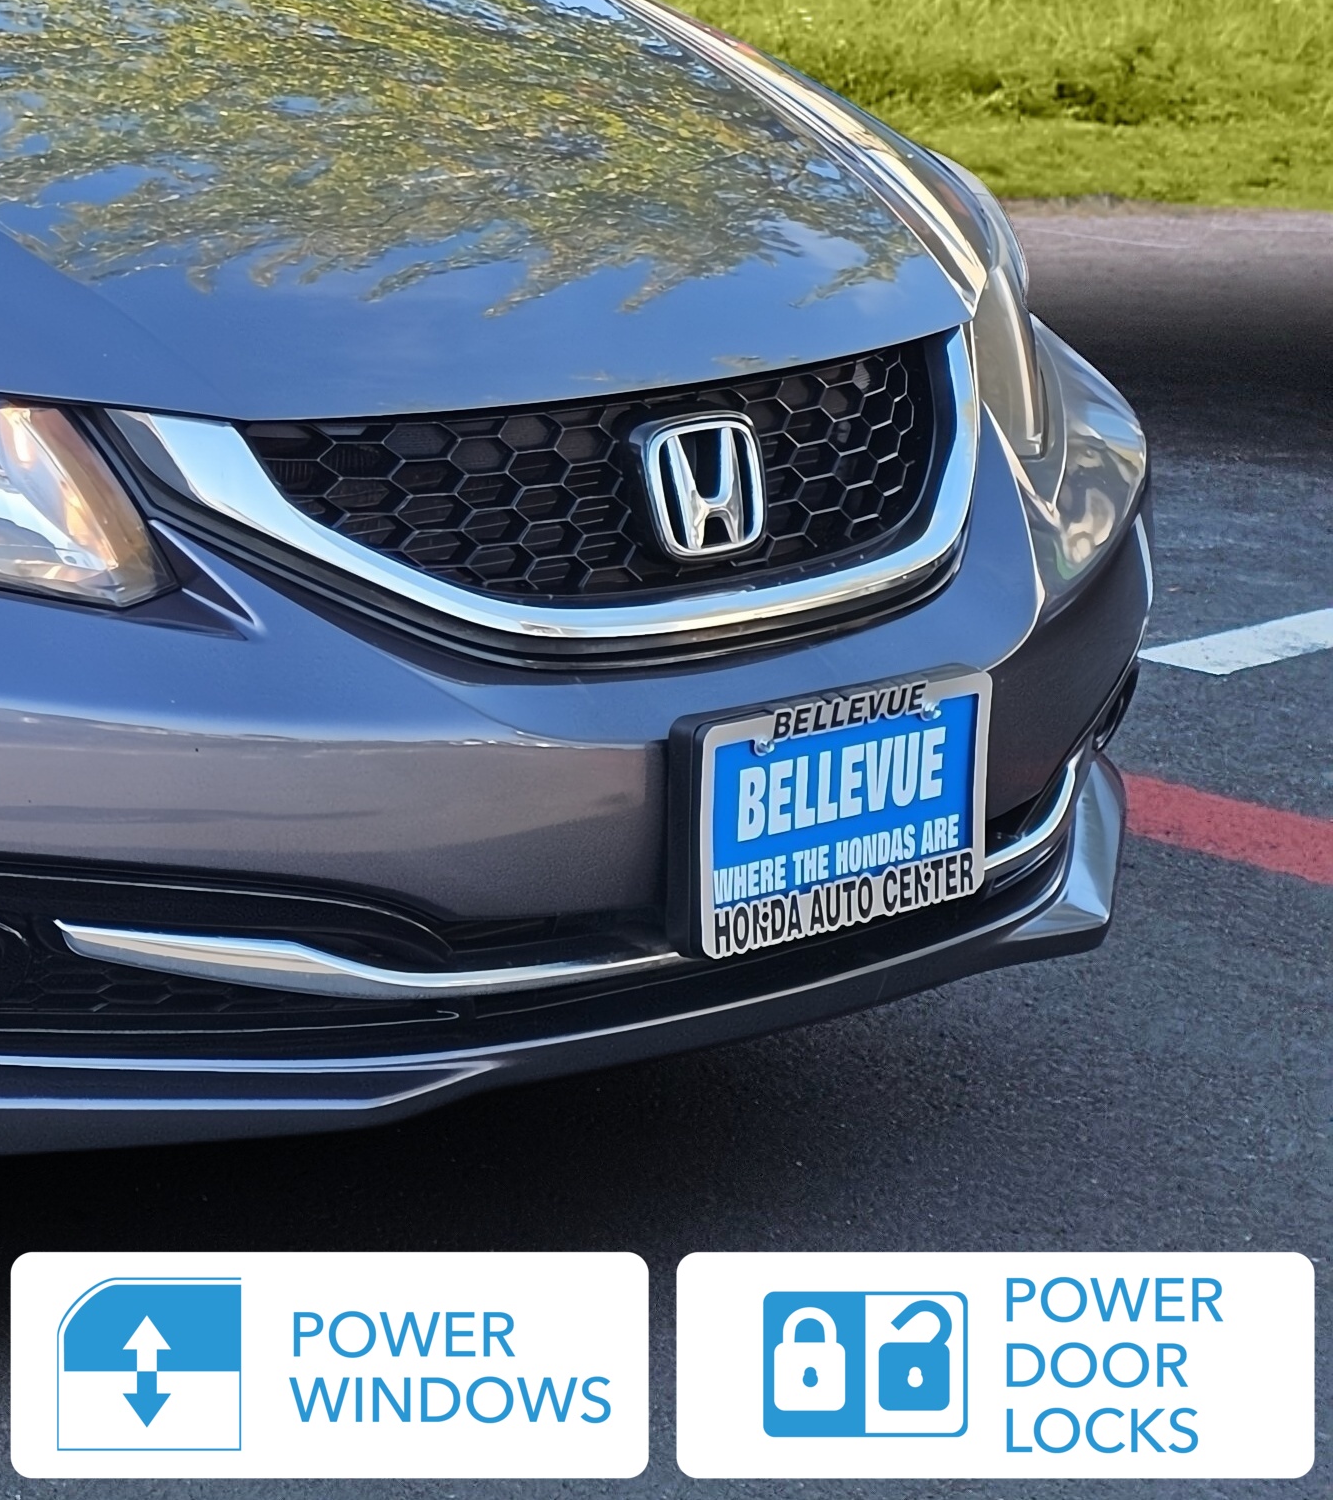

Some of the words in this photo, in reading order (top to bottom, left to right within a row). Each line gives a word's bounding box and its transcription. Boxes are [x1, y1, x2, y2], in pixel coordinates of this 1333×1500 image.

[773, 683, 927, 741] BELLEVUE
[737, 727, 947, 843] BELLEVUE
[714, 854, 787, 905] WHERE
[792, 845, 829, 886] THE
[835, 824, 916, 876] HONDAS
[920, 814, 960, 854] ARE
[714, 895, 802, 955] HONDA
[809, 876, 872, 932] AUTO
[883, 852, 974, 915] CENTER
